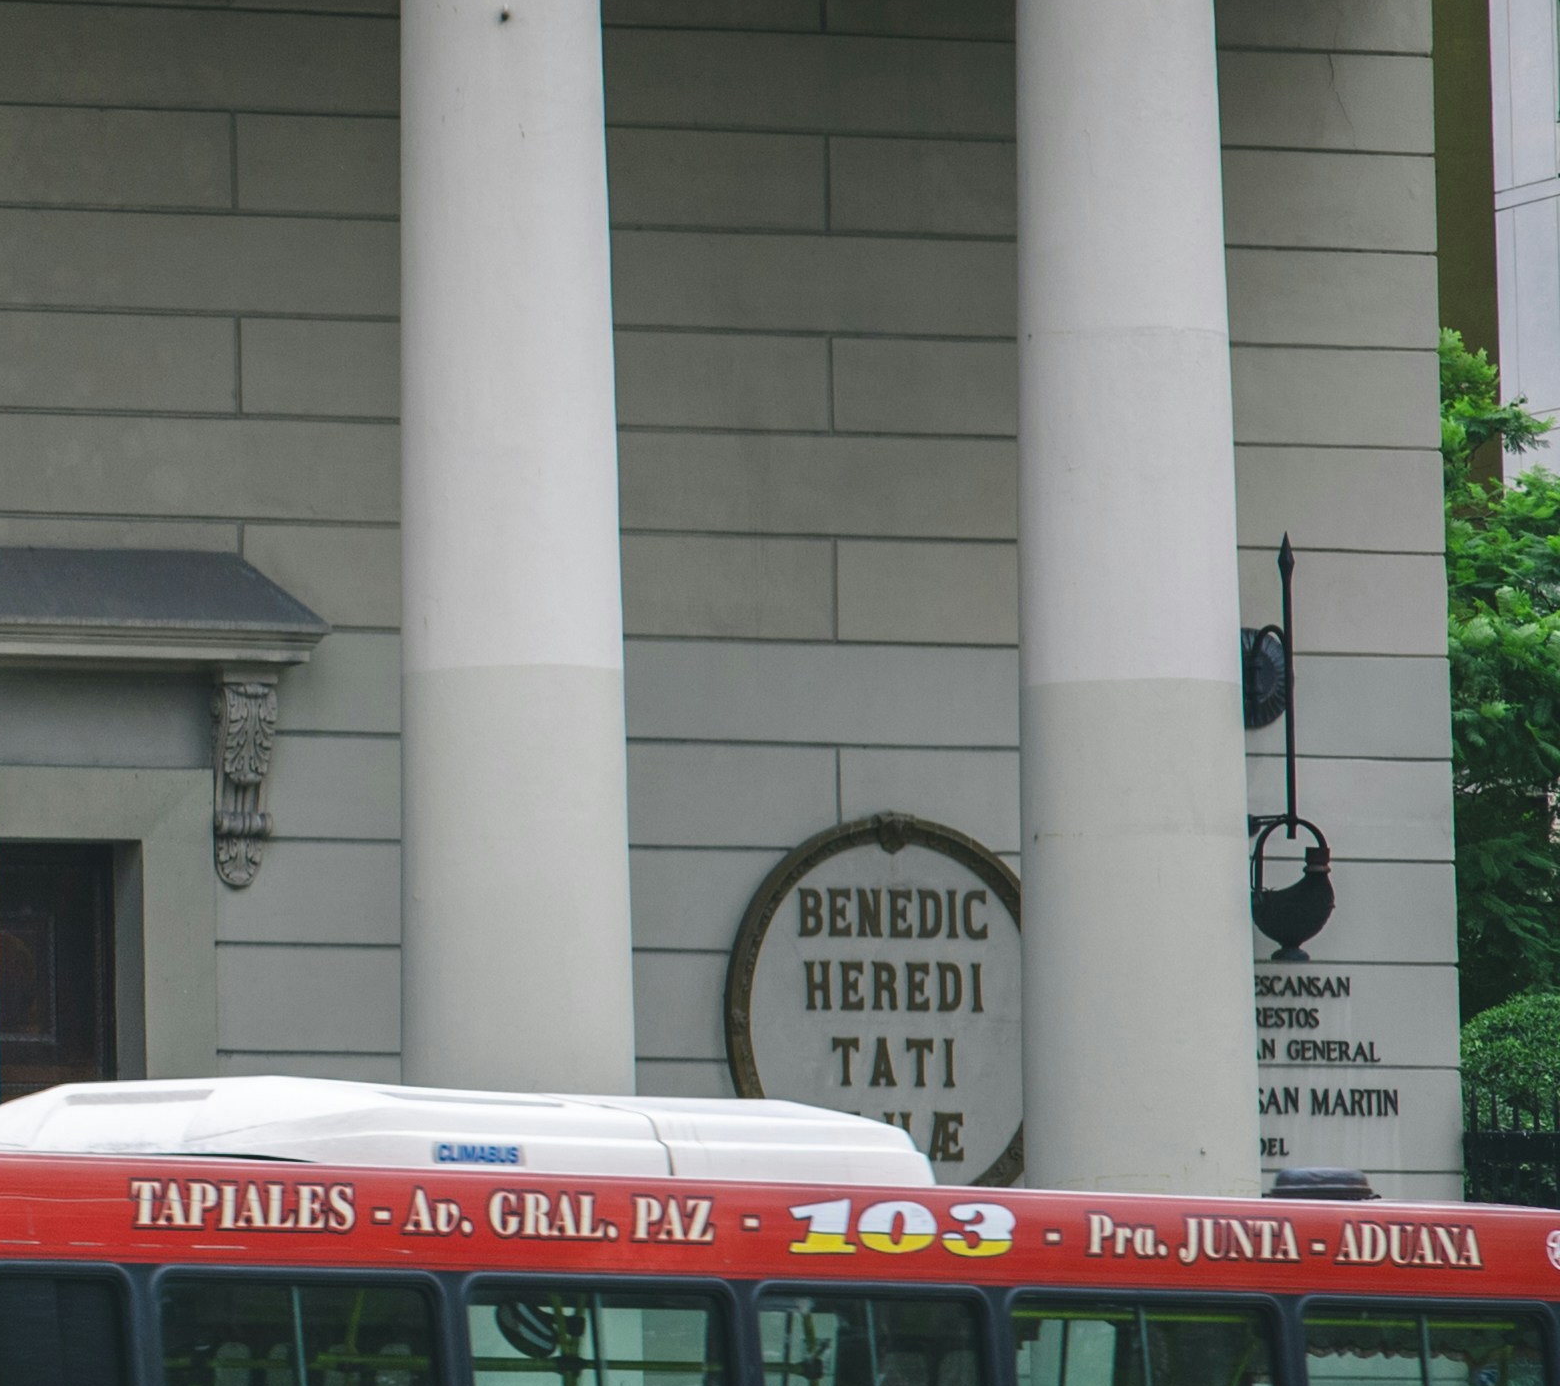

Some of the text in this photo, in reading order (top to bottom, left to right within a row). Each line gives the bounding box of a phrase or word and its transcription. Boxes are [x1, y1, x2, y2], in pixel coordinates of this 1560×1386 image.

[797, 886, 989, 940] BENEDIC
[804, 960, 984, 1013] HEREDI
[832, 1036, 956, 1088] TATI
[1287, 1039, 1381, 1063] GENERAL
[1311, 1088, 1399, 1117] MARTIN
[436, 1143, 521, 1165] CLIMABUS
[131, 1179, 357, 1233] TAPIALES
[403, 1186, 474, 1237] Av.
[488, 1189, 619, 1241] GRAL.
[631, 1194, 717, 1245] PAZ
[788, 1198, 1017, 1257] 103
[1085, 1211, 1168, 1261] Pra.
[1178, 1217, 1300, 1265] JUNTA
[1334, 1220, 1484, 1269] ADUANA
